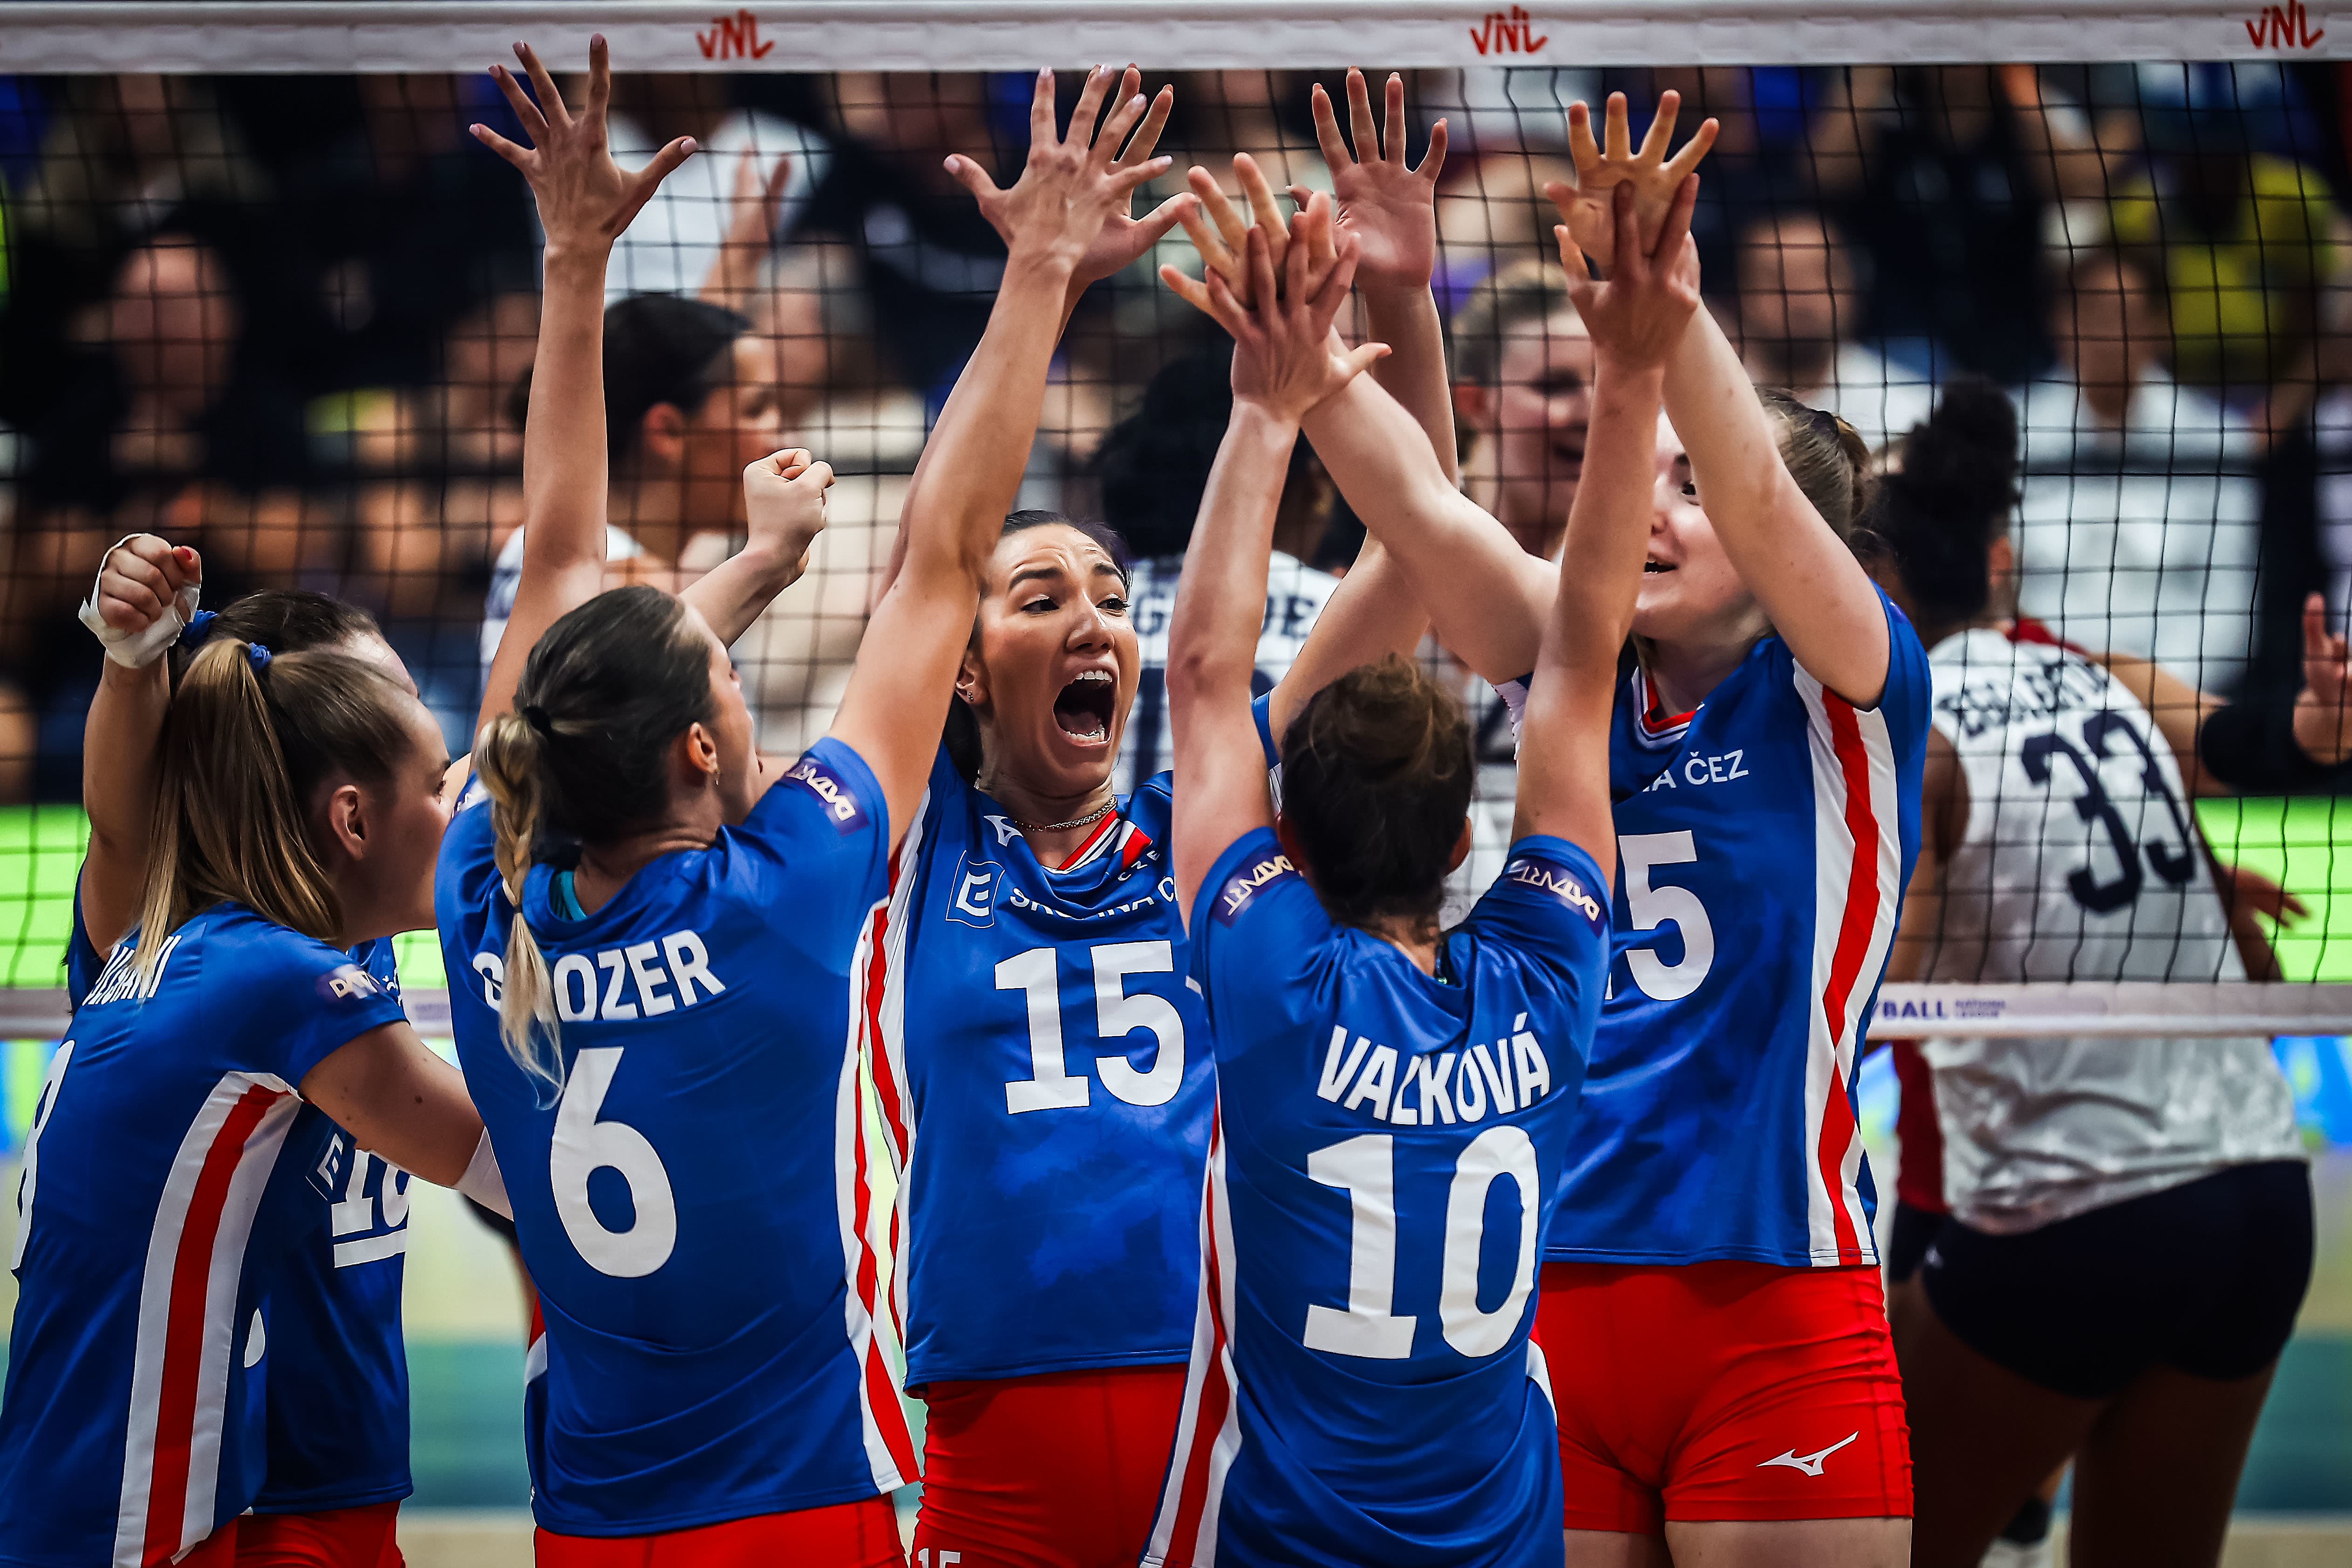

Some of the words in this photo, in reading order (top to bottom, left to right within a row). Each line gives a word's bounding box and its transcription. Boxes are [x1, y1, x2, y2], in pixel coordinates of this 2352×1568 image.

[695, 8, 775, 60] VNL
[1470, 4, 1548, 55] VNL
[2245, 0, 2325, 49] VNL
[1685, 749, 1749, 785] ČEZ
[2021, 710, 2195, 914] 33
[1605, 830, 1715, 1001] 5
[472, 929, 726, 1023] GOZER
[994, 940, 1186, 1115] 15
[1316, 1012, 1551, 1126] VALKOVÁ
[550, 1046, 677, 1278] 6
[1304, 1125, 1540, 1359] 10
